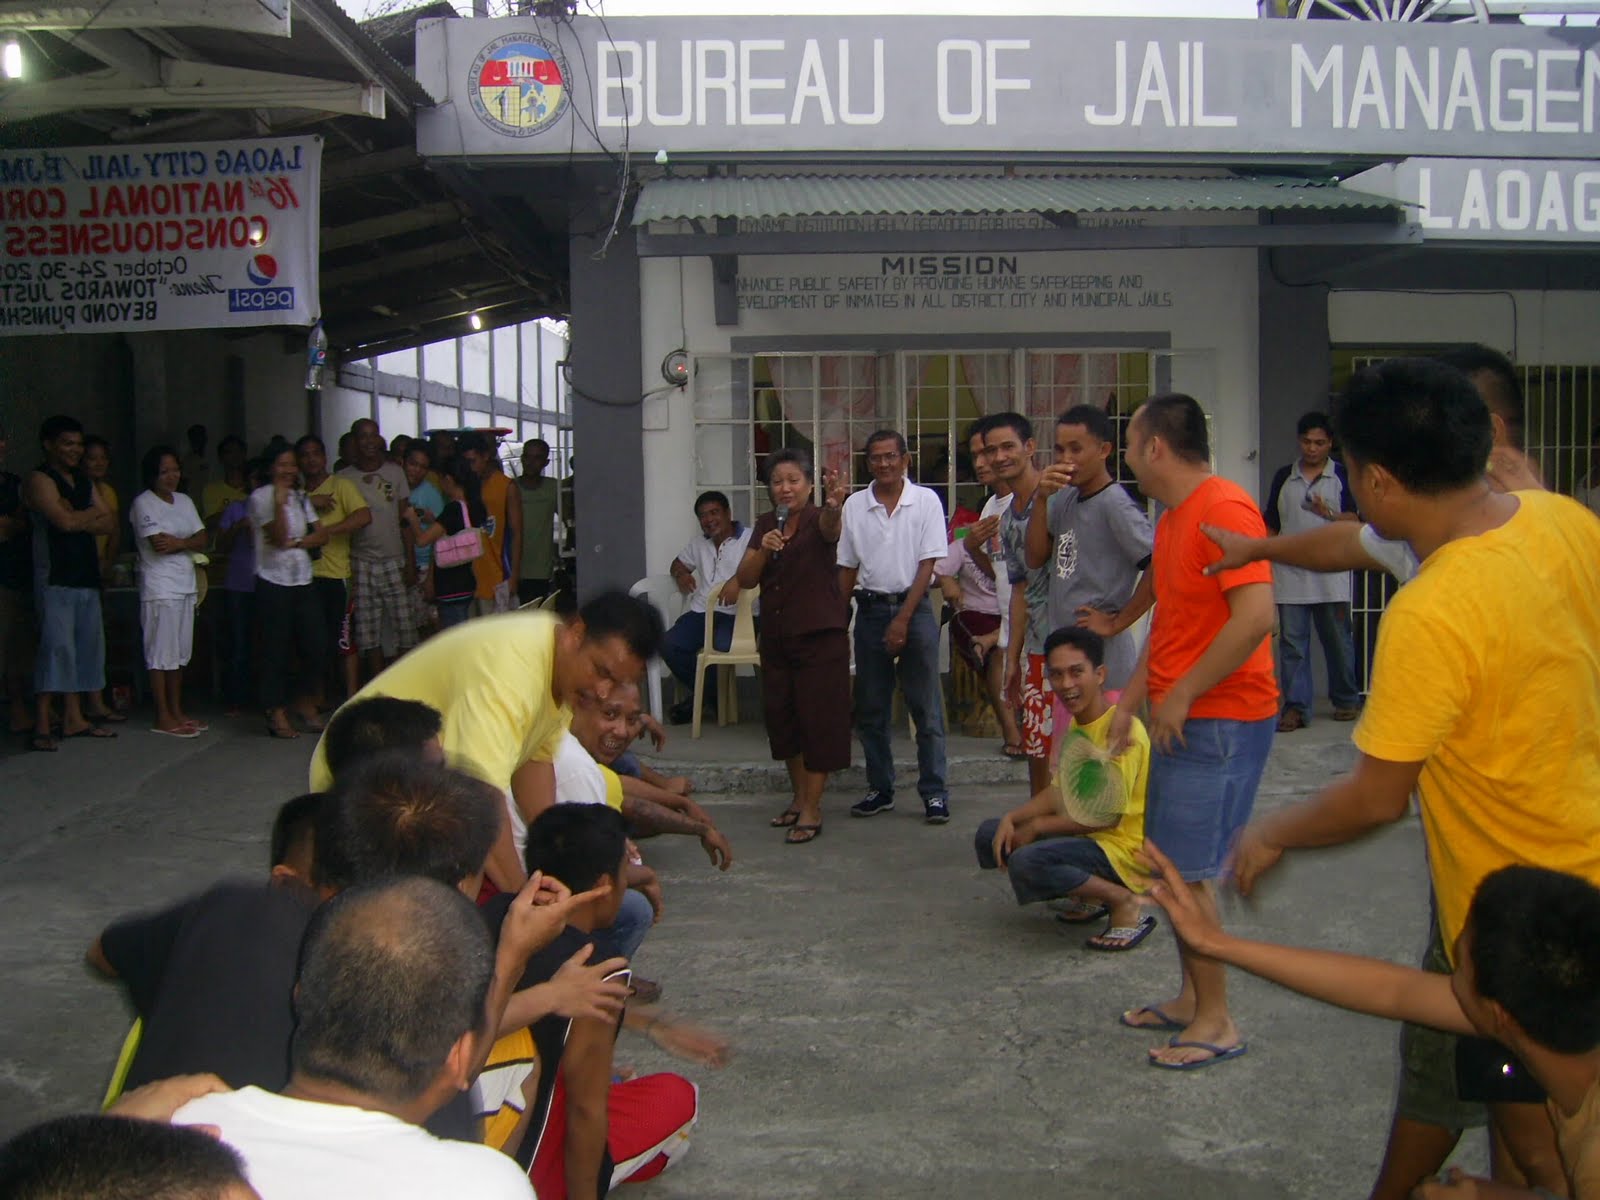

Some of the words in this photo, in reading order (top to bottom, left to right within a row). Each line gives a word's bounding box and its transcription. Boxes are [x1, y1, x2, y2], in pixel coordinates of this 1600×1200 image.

[597, 39, 885, 127] BUREAU
[937, 39, 1031, 127] OF
[1084, 40, 1239, 128] JAIL
[1418, 168, 1600, 232] LAOAG
[882, 256, 1018, 275] MISSION
[737, 277, 785, 291] NHANCE
[789, 277, 832, 291] PUBLIC
[839, 276, 888, 291] SAFETY
[893, 276, 910, 290] BY
[913, 276, 973, 290] PROVIDING
[977, 275, 1026, 290] HUMANE
[1031, 274, 1113, 289] SAFEKEEPING
[1119, 274, 1144, 289] AND
[736, 294, 818, 309] EVELOPMENT
[824, 294, 841, 309] OF
[846, 294, 899, 309] INMATES
[904, 294, 916, 308] IN
[920, 293, 948, 308] ALL
[1011, 293, 1037, 308] CITY
[1044, 292, 1067, 307] AND
[1072, 292, 1133, 307] MUNICIPAL
